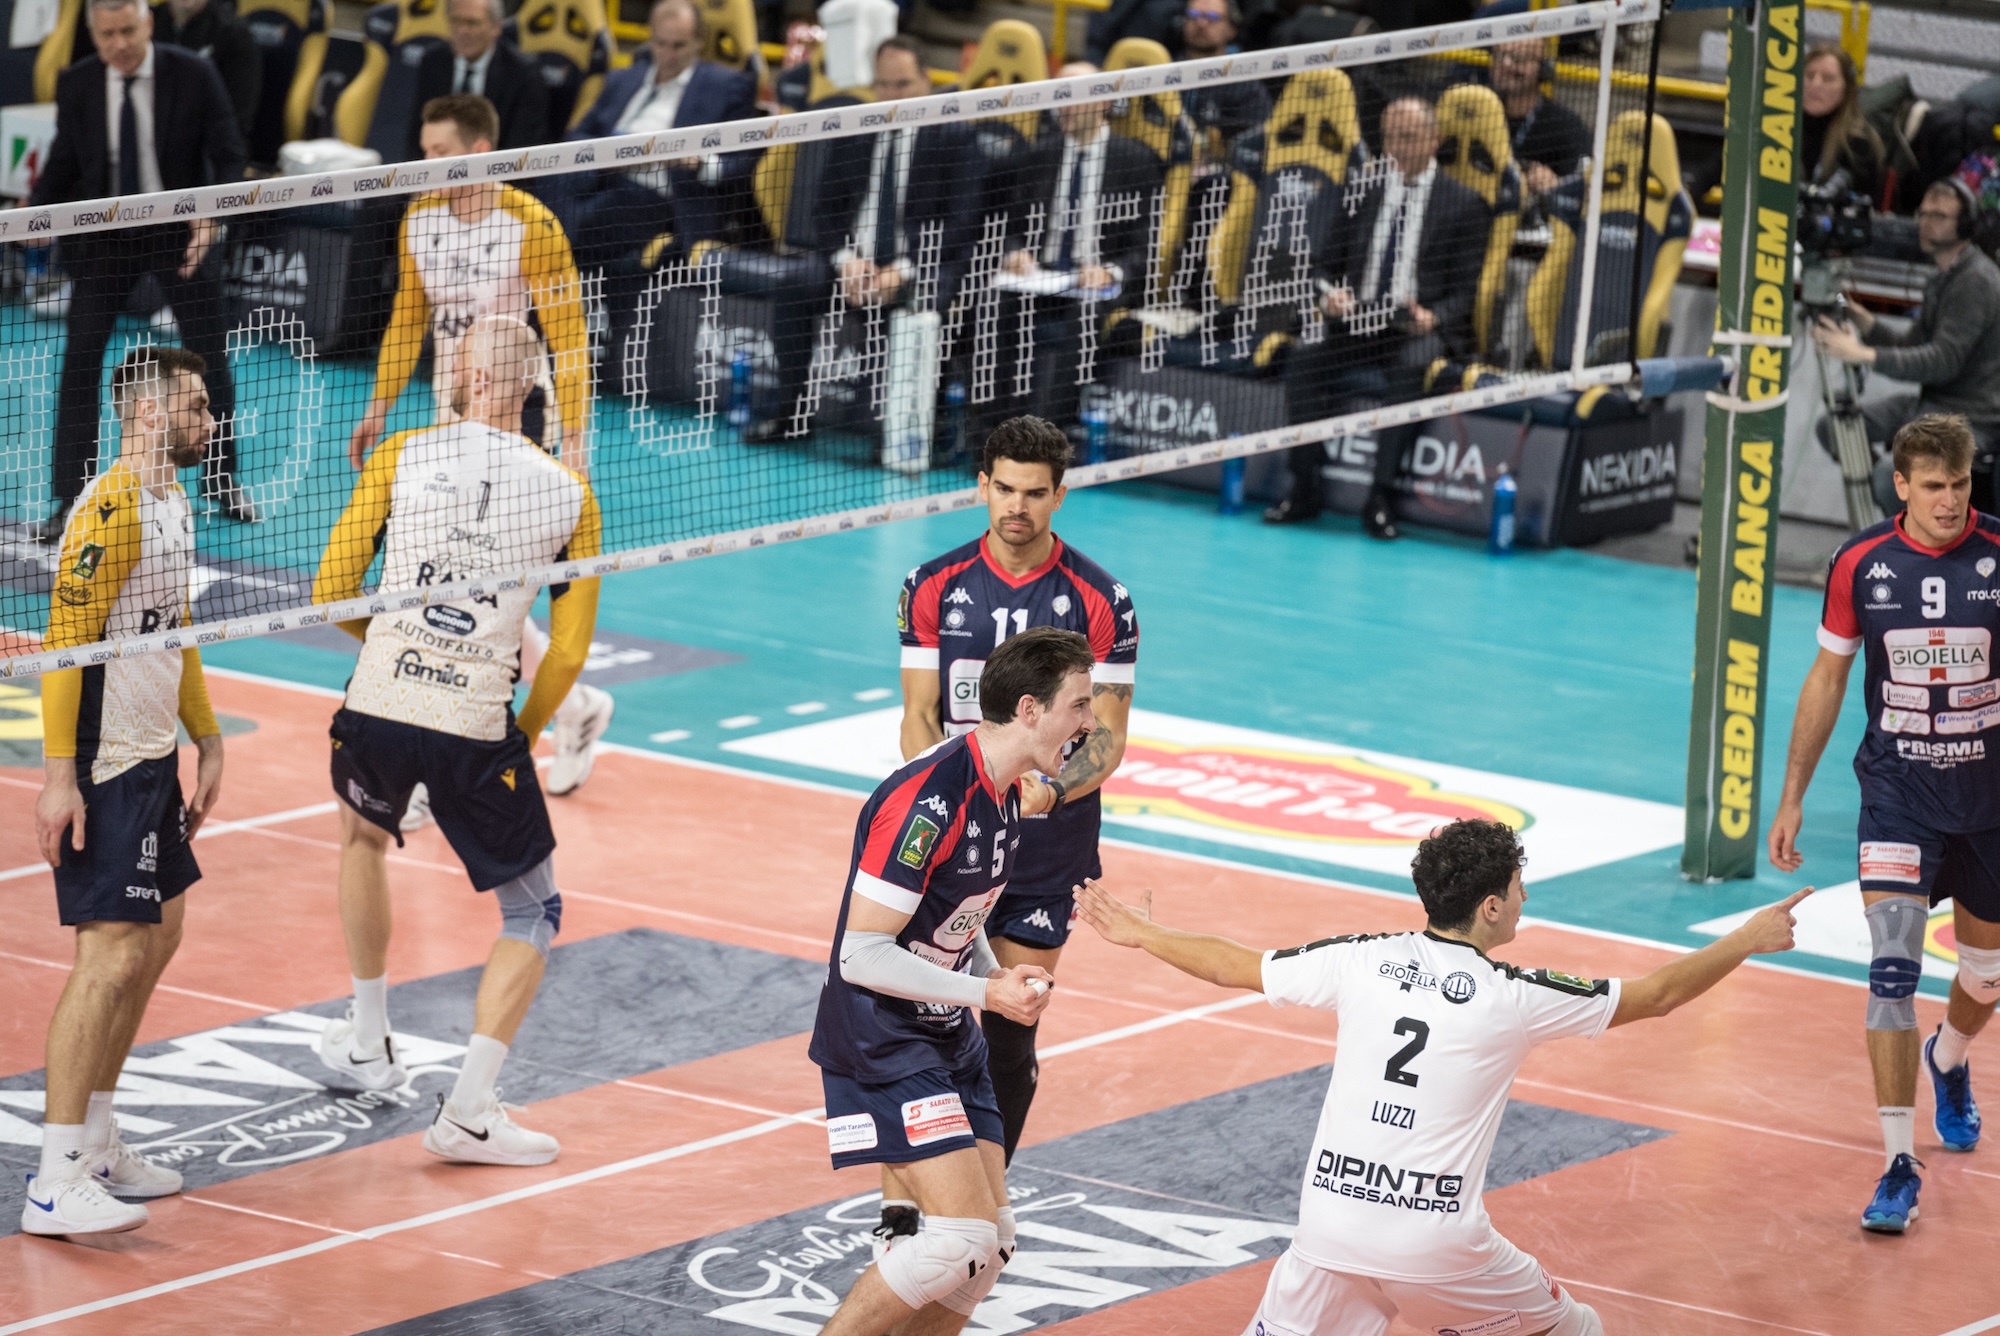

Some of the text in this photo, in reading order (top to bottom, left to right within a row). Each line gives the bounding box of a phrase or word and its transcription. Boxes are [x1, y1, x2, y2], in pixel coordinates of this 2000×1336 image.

[27, 218, 50, 232] RANA
[173, 201, 195, 215] RANA
[311, 183, 332, 197] RANA
[447, 166, 468, 180] RANA
[1747, 4, 1799, 401] CREDEM BANCA
[1580, 441, 1676, 496] NEXIDIA
[1921, 576, 1946, 619] 9
[427, 608, 473, 630] Bonomi
[991, 606, 1028, 648] 11
[1928, 629, 1946, 638] 1946
[57, 656, 75, 668] RANA
[164, 636, 181, 649] RANA
[268, 619, 284, 631] RANA
[1719, 441, 1773, 839] CREDEM BANCA
[1892, 646, 1985, 666] GIOIELLA
[394, 649, 469, 688] famila
[1896, 738, 1985, 758] PRISMA
[991, 829, 1007, 879] 5
[1379, 963, 1437, 989] GIOIELLA
[1410, 958, 1421, 967] 1946
[1384, 1016, 1430, 1088] 2
[829, 1121, 873, 1133] Fratelli Tarantini
[1371, 1100, 1416, 1130] LUZZI
[1317, 1149, 1463, 1198] DIPINTO
[1312, 1174, 1460, 1213] DALESSANDRO
[1460, 1324, 1485, 1334] Fratelli
[1486, 1314, 1516, 1327] Tarantini
